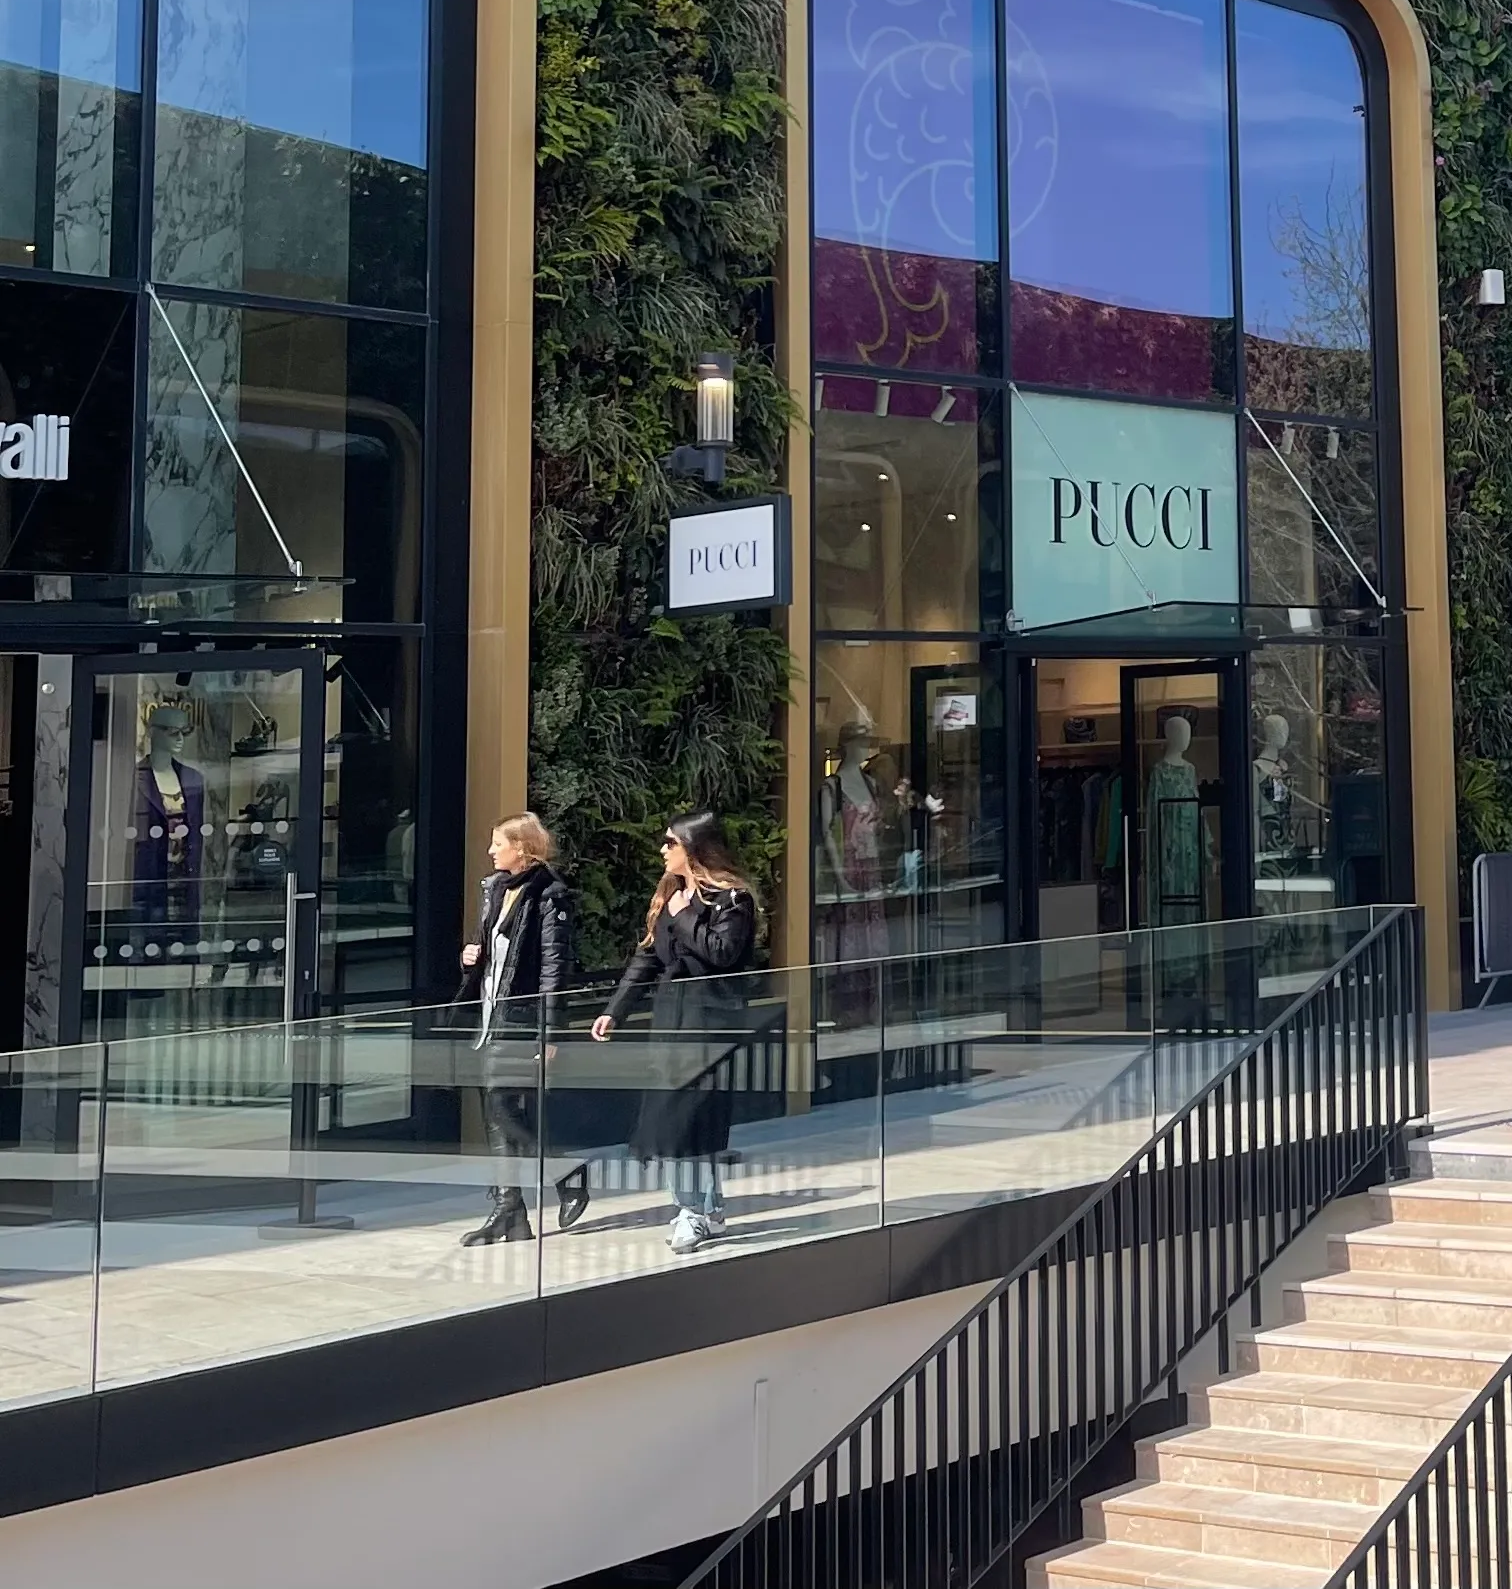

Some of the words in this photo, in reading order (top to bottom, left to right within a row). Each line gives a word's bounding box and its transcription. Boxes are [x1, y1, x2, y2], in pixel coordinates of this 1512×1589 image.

[0, 413, 70, 481] alli
[1049, 476, 1213, 551] PUCCI
[689, 540, 757, 575] PUCCI
